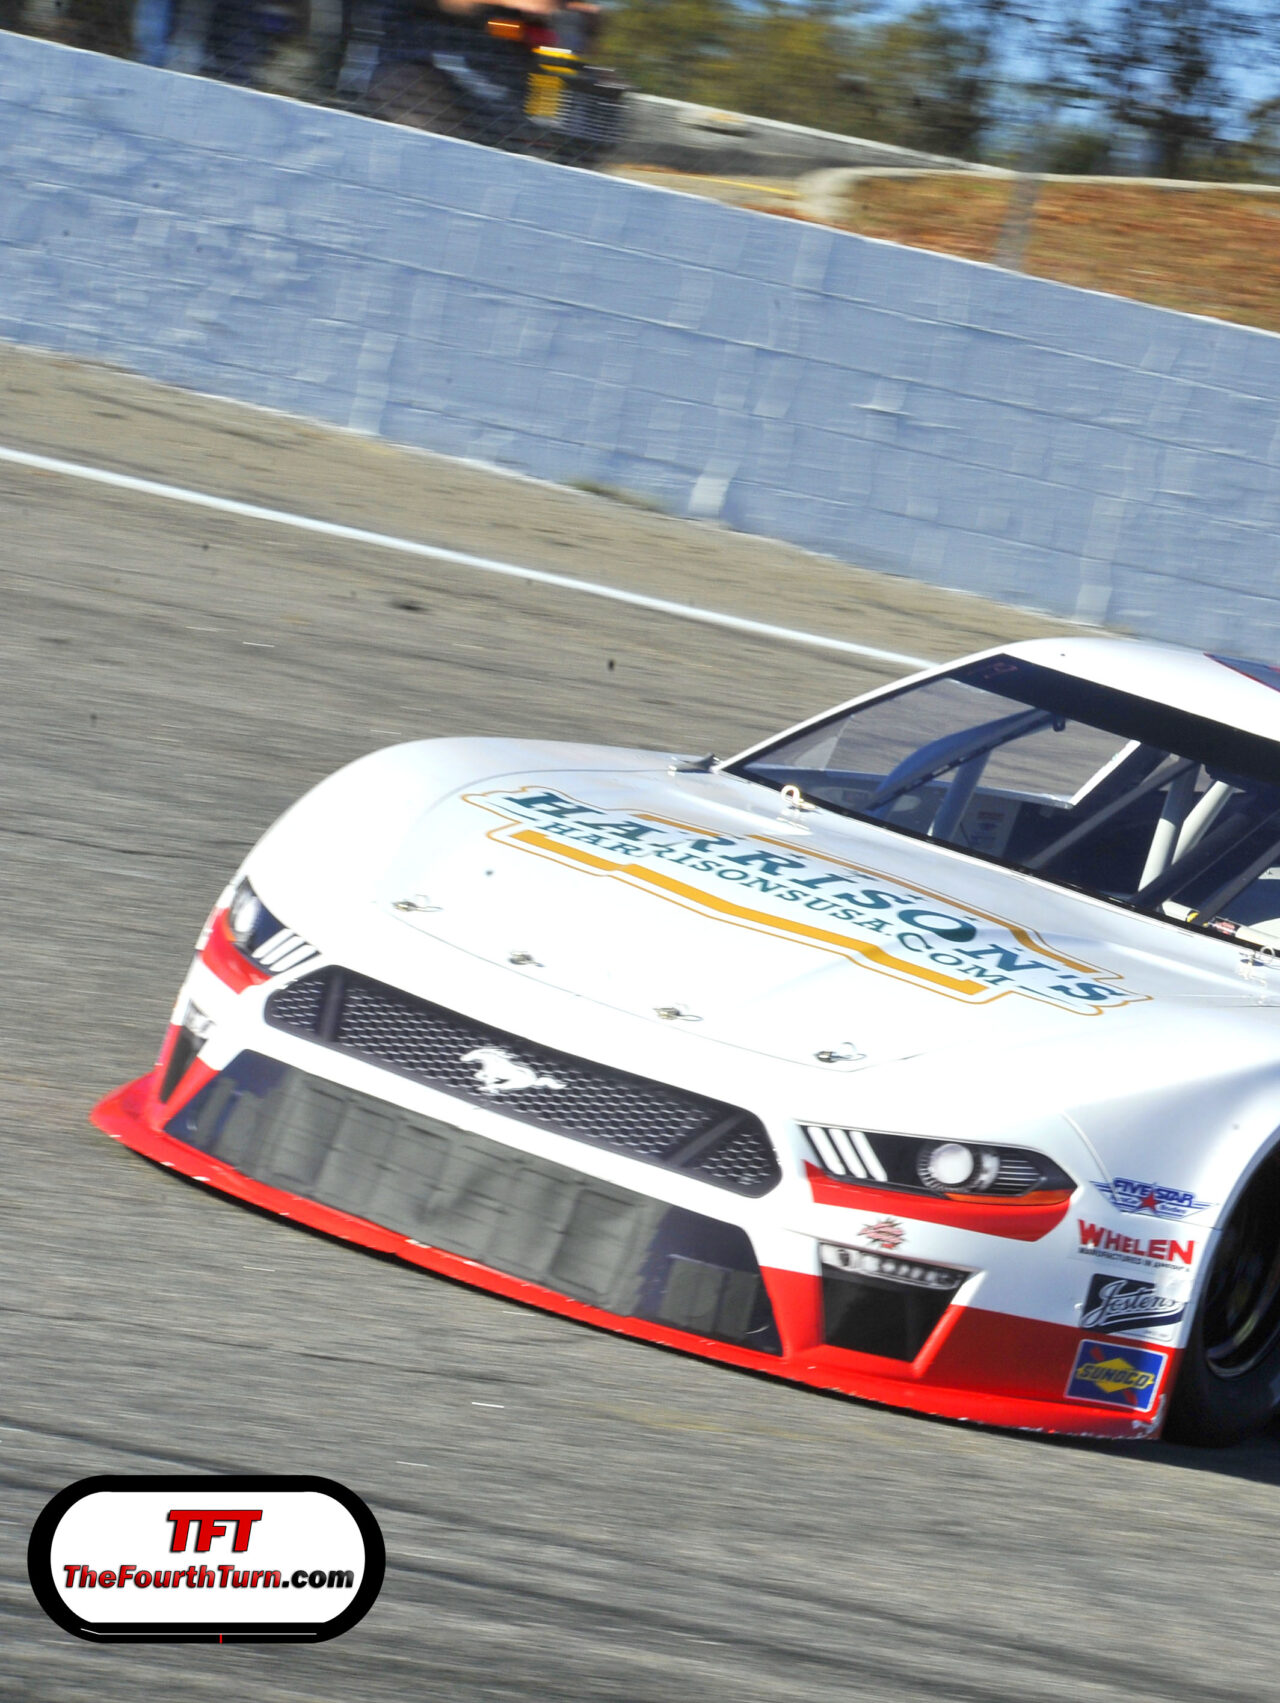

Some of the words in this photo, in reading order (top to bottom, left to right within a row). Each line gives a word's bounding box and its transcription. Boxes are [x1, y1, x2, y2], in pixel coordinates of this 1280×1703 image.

[503, 791, 1130, 1003] HARRISON'S
[537, 820, 1018, 987] HARRISONSUSA.COM
[1113, 1178, 1151, 1197] FIVE
[1155, 1187, 1193, 1207] STAR
[1078, 1219, 1195, 1265] WHELEN
[1079, 1364, 1151, 1389] SUNOCO
